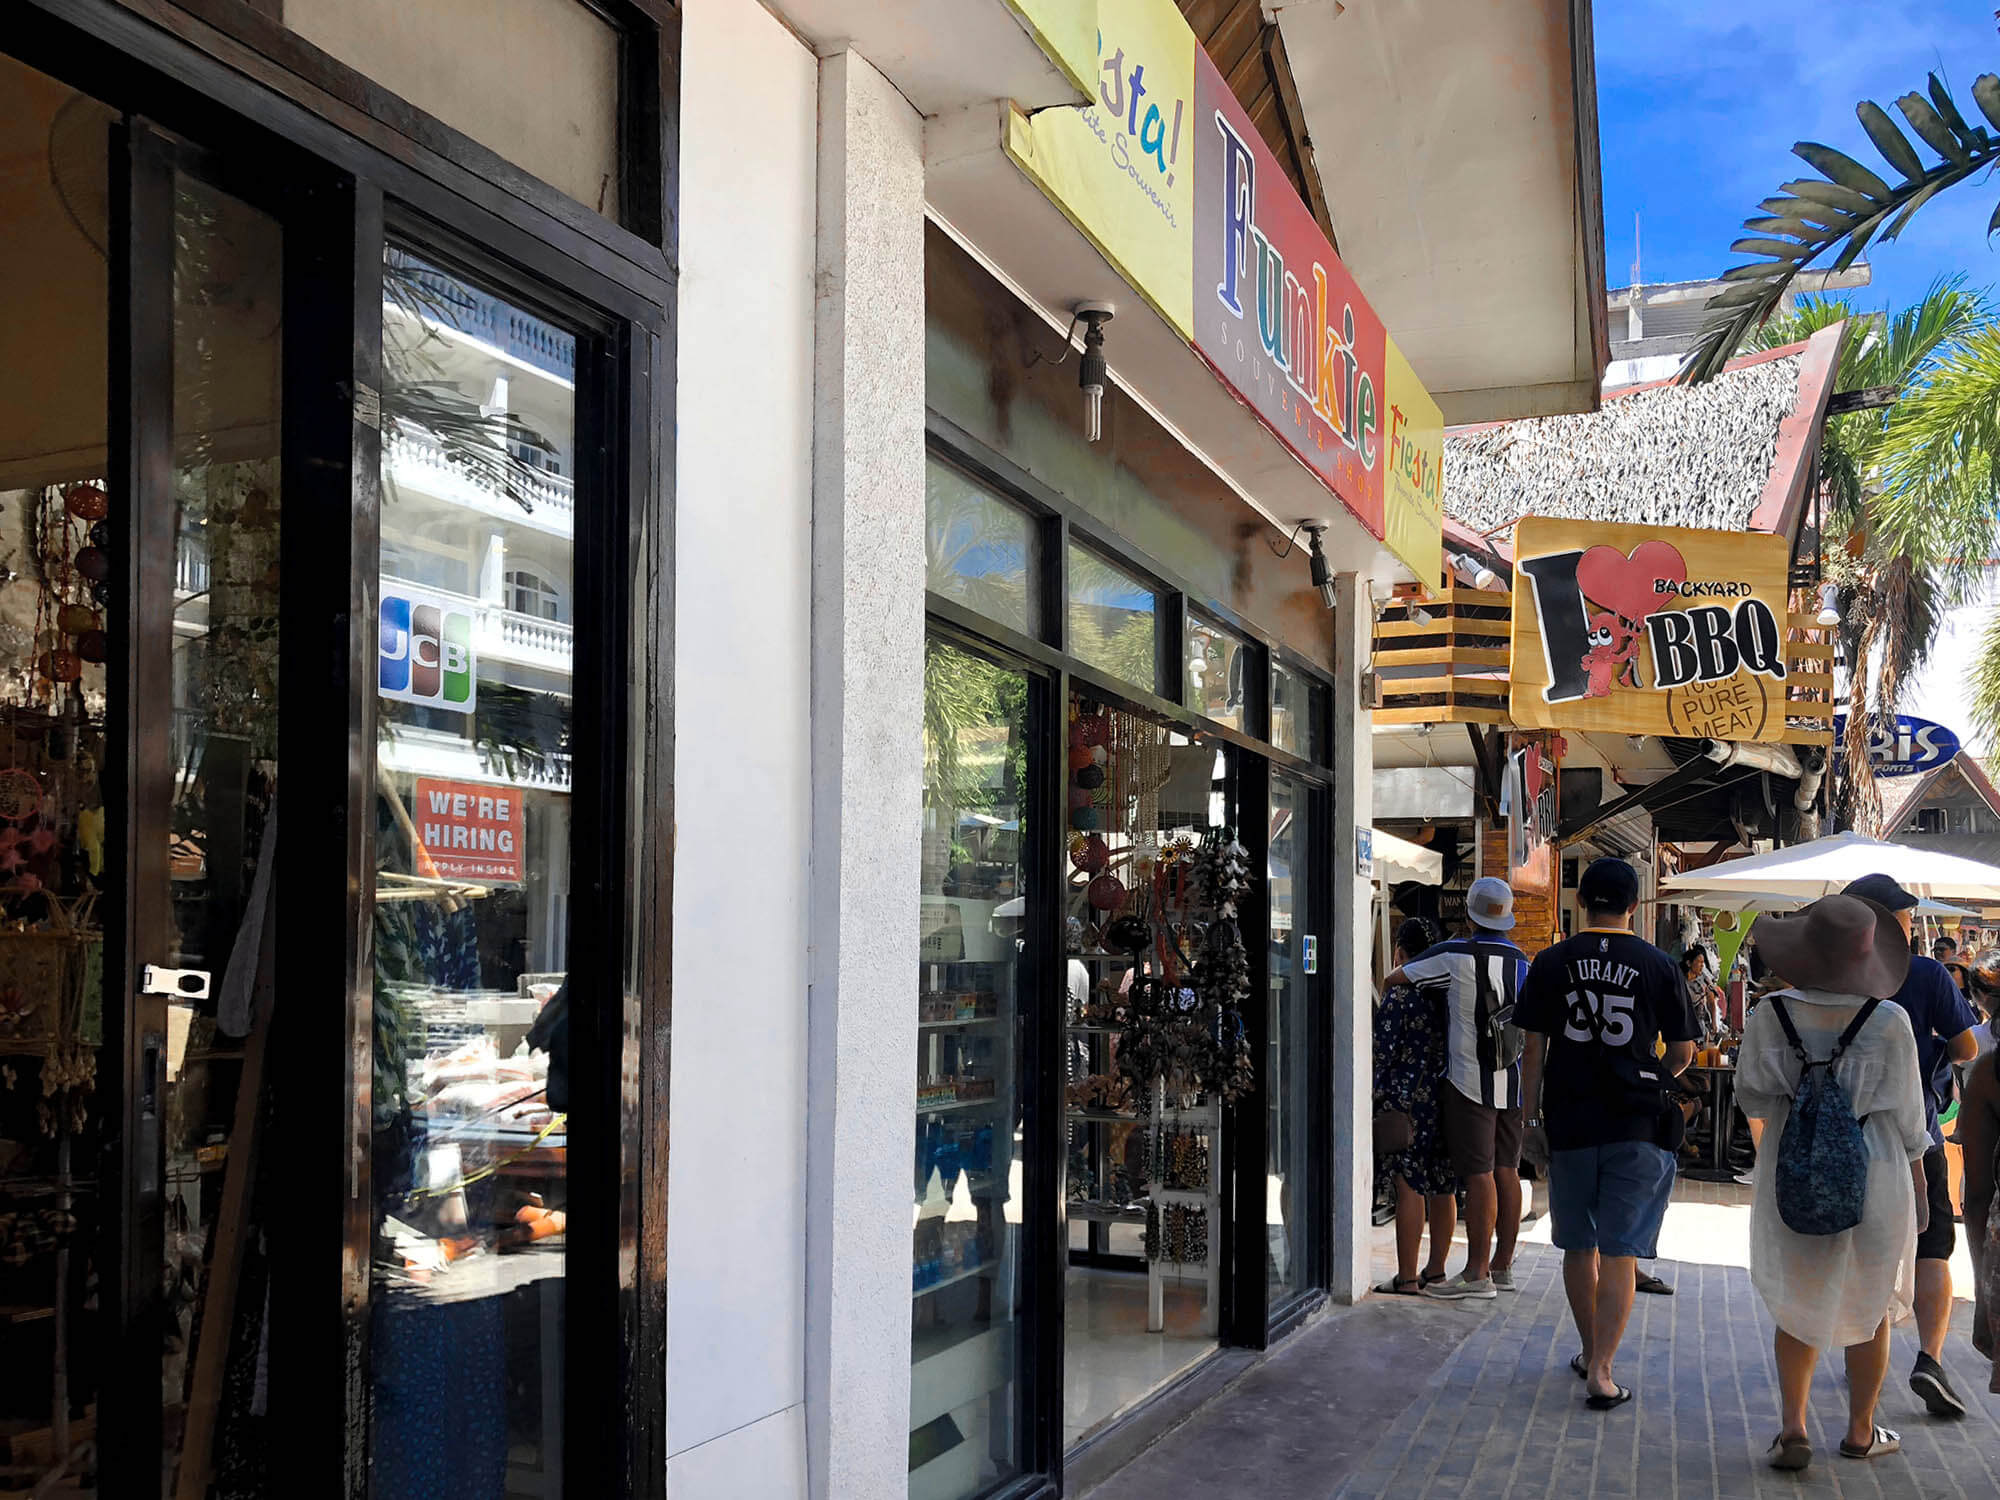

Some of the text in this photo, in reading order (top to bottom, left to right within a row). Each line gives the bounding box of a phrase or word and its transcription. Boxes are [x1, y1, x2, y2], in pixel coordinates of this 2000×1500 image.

[1096, 28, 1184, 188] sta!
[1215, 109, 1377, 472] Funkie
[1220, 320, 1324, 453] SOUVENIR
[1389, 403, 1443, 512] Fiesta!
[1653, 578, 1752, 598] BACKYARD
[380, 630, 468, 674] JCB
[1645, 599, 1786, 689] BBQ
[1682, 683, 1750, 722] PURE
[1691, 706, 1754, 738] MEAT
[428, 790, 510, 821] WE'RE
[424, 822, 514, 852] HIRING
[471, 864, 515, 876] INSIDE
